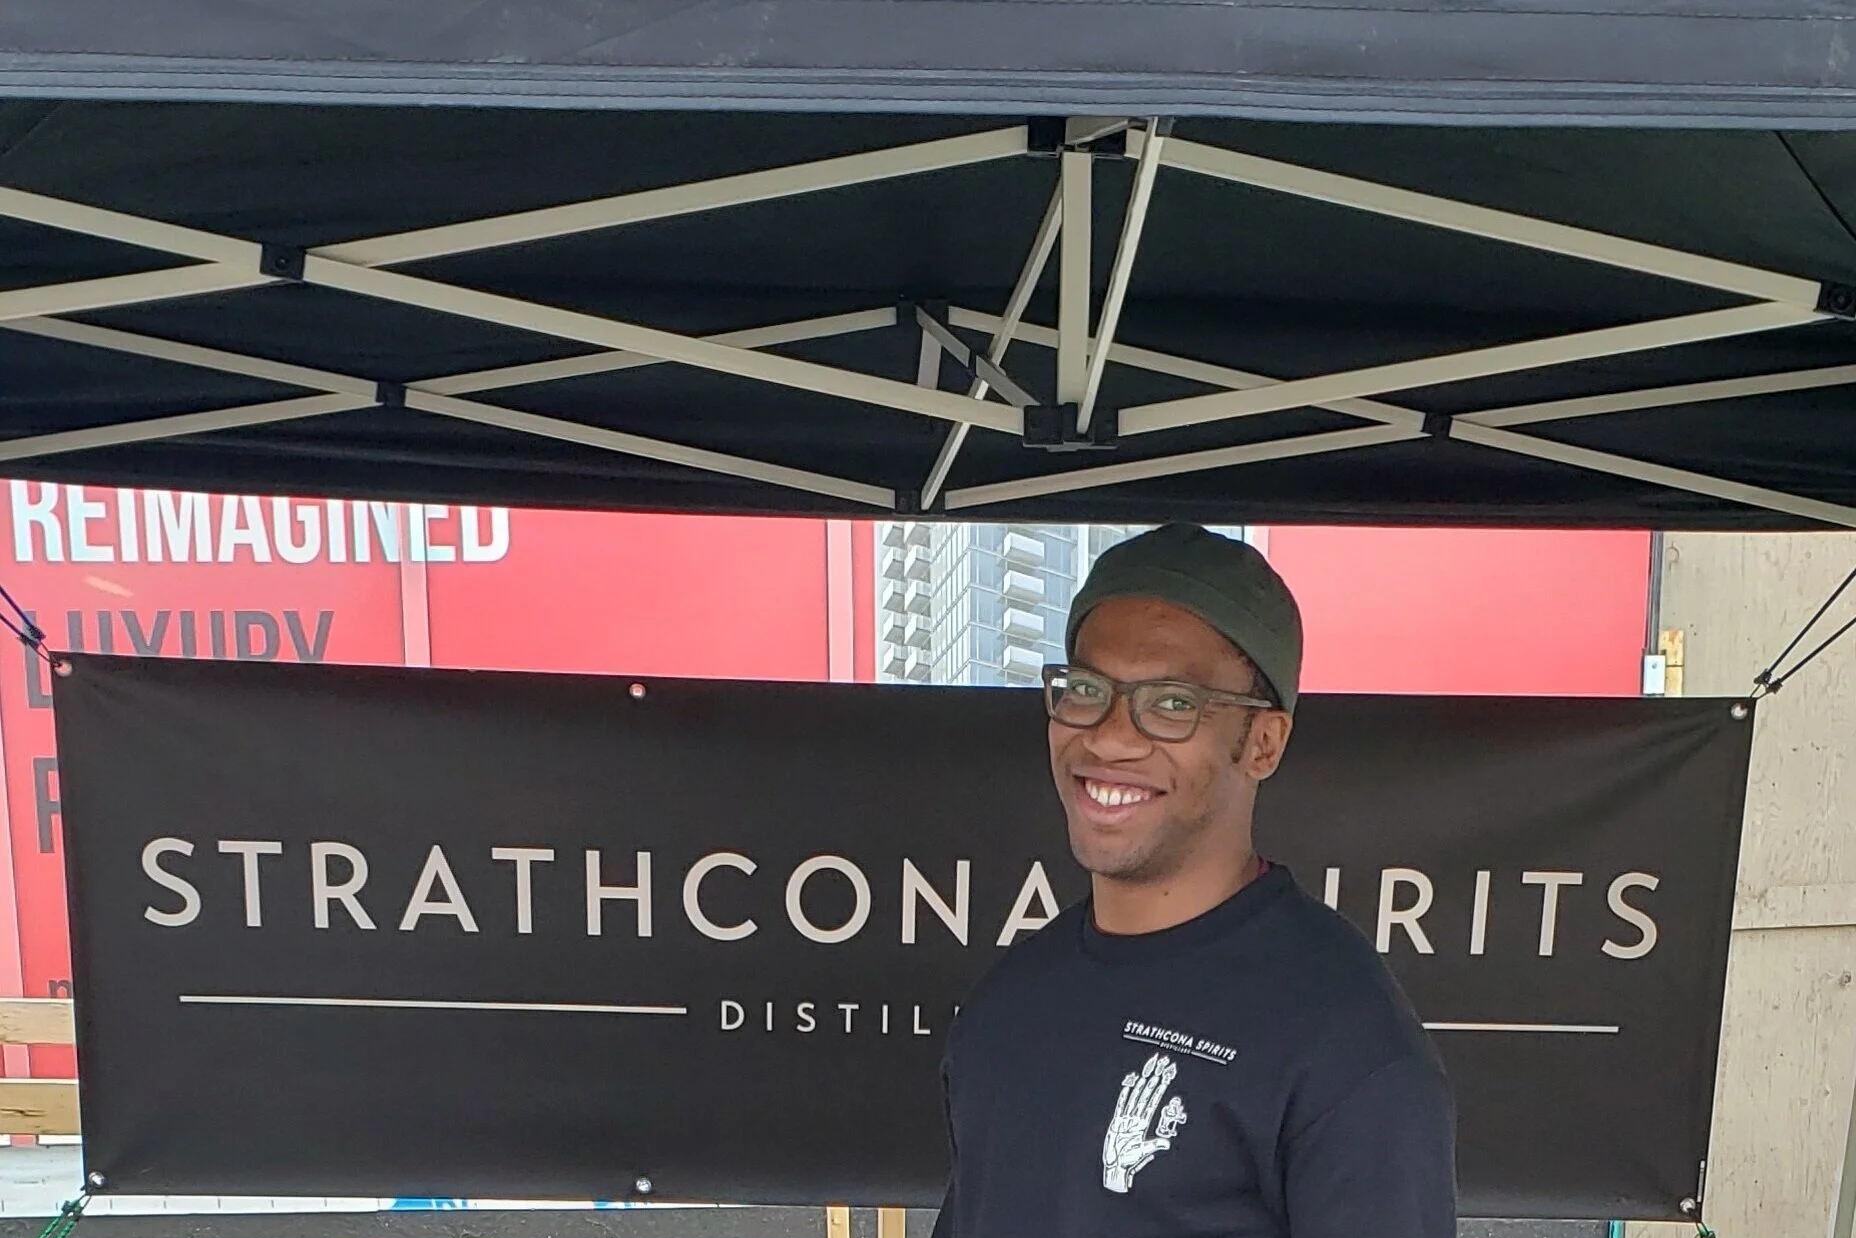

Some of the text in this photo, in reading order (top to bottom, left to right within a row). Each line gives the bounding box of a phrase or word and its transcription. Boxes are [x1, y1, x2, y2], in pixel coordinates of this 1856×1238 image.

[8, 479, 510, 563] REIMAGINED
[142, 837, 1660, 959] STRATHCONA IRITS
[720, 1000, 959, 1035] DISTIL
[1123, 1021, 1237, 1061] STRATHCONA SPIRITS
